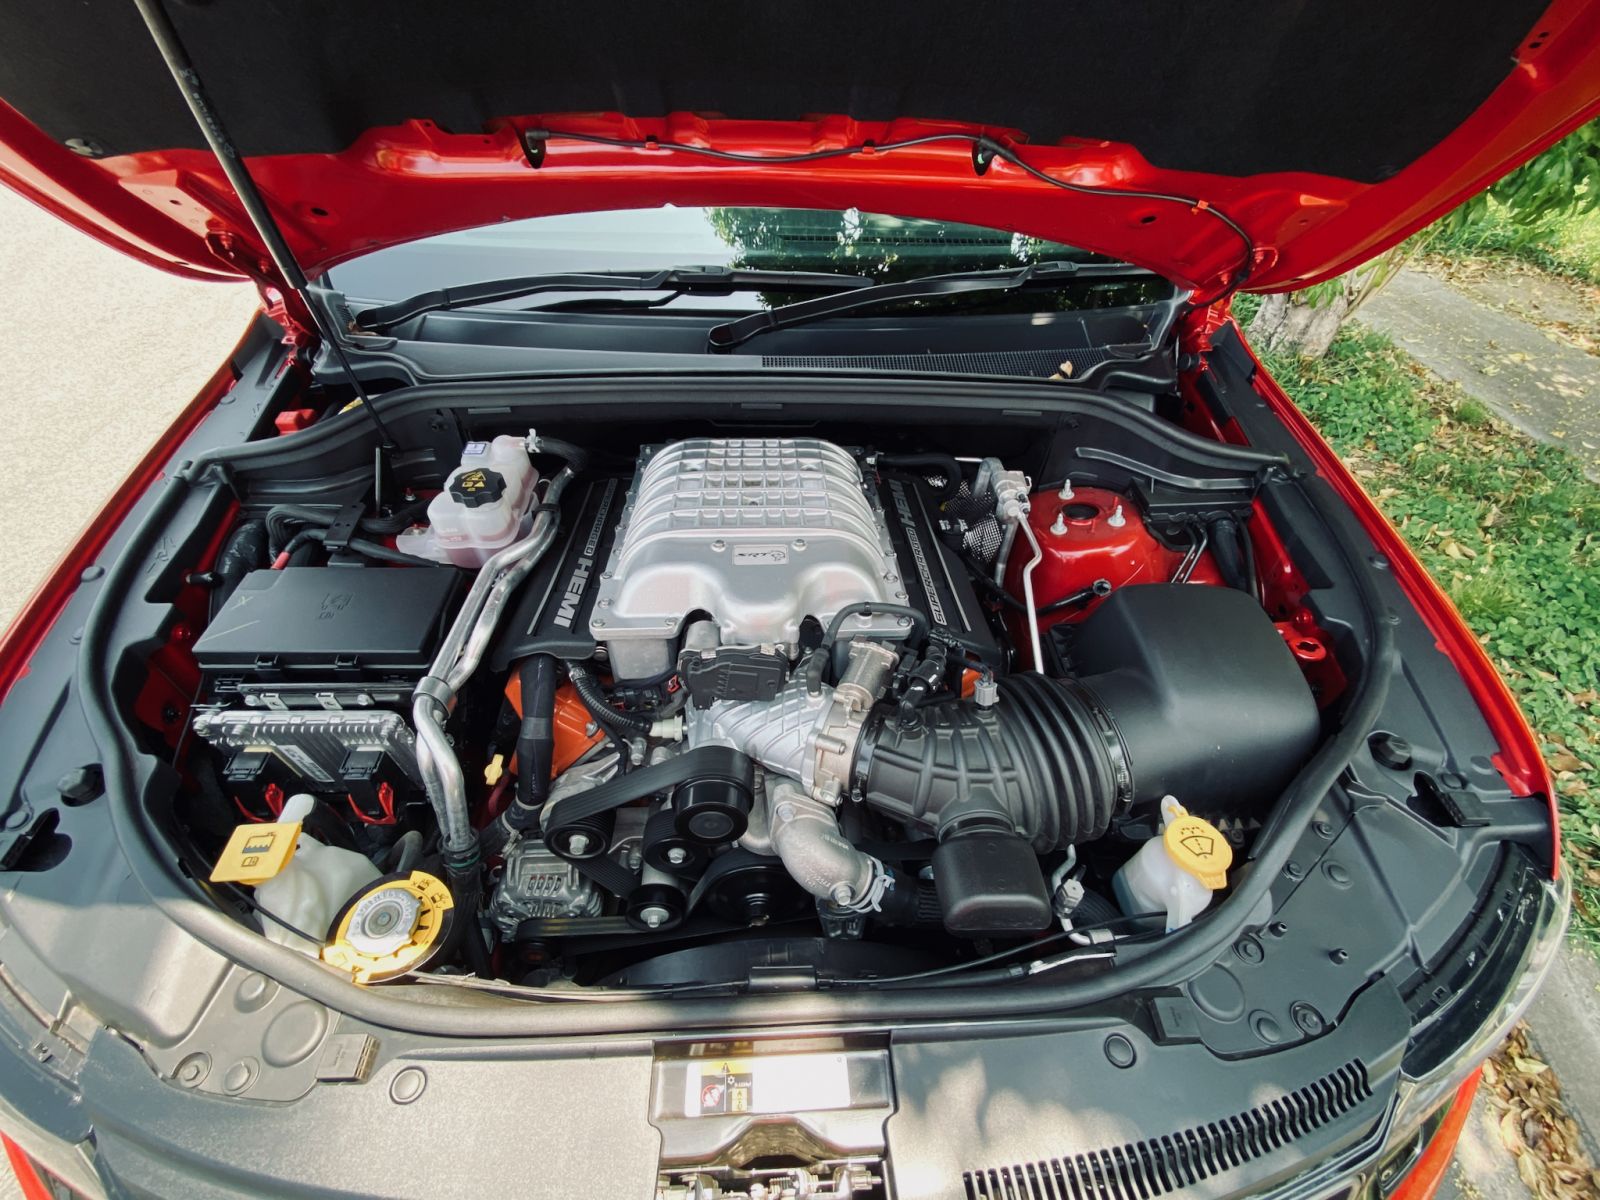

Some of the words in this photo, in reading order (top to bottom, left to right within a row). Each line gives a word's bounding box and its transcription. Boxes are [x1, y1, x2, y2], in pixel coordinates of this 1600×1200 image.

[888, 479, 916, 527] HEMI
[554, 557, 593, 628] HEMI
[907, 528, 946, 624] SUPERCHARGED
